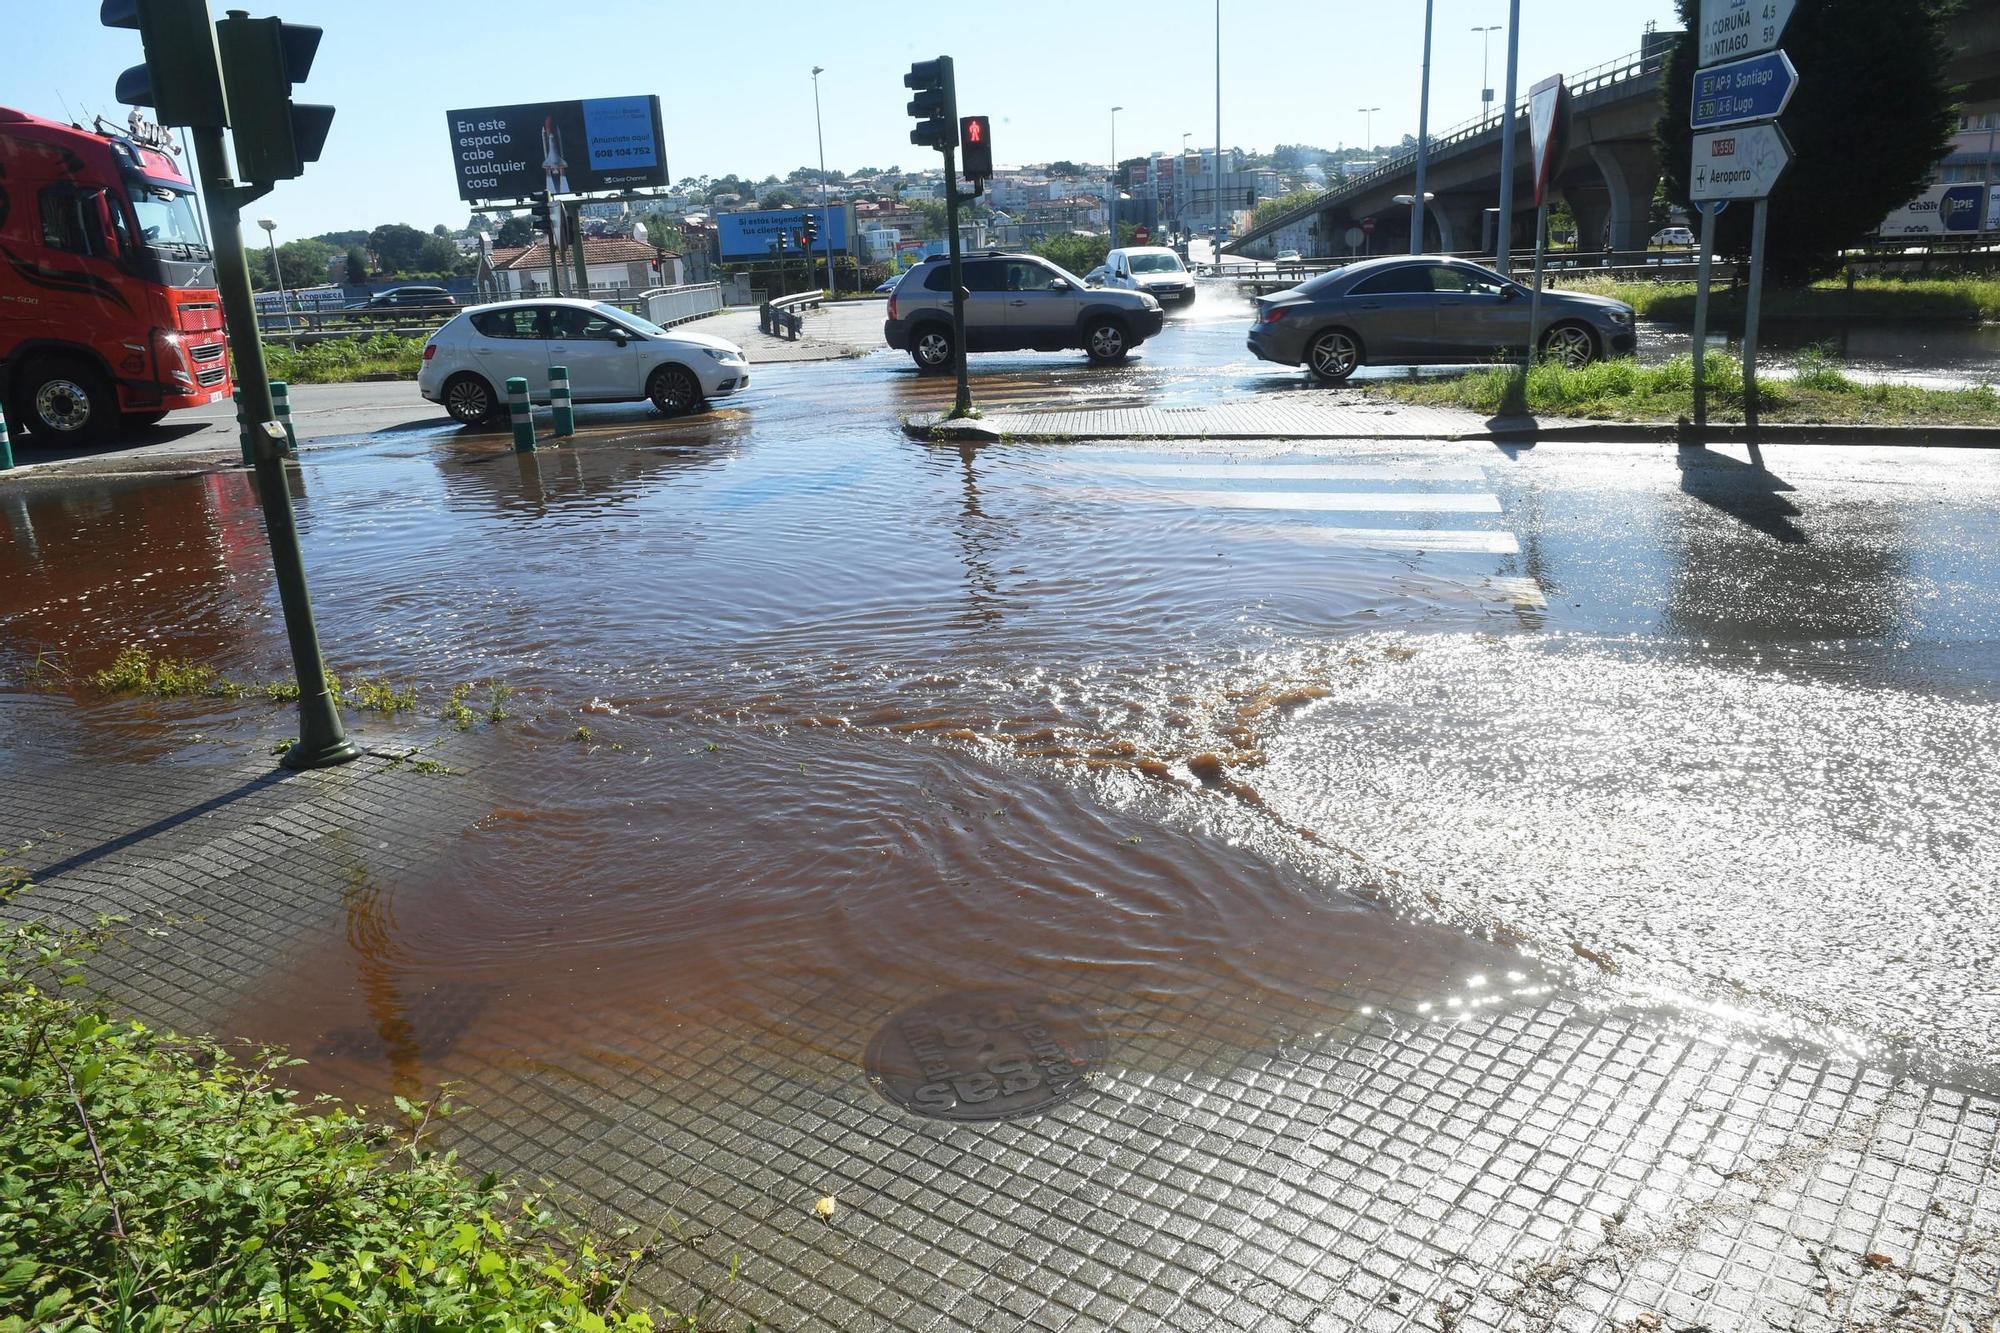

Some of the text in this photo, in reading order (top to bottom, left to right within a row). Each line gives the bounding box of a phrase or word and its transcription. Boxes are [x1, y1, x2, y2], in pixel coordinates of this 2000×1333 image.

[1712, 8, 1750, 36] CORUÑA
[1763, 25, 1774, 43] 59
[1715, 74, 1731, 91] AP-9
[1736, 69, 1773, 88] Santiago
[1733, 97, 1753, 113] Lugo
[457, 120, 506, 133] En este
[460, 132, 511, 148] espacio
[1712, 140, 1734, 156] N-550
[462, 149, 494, 161] cabe
[464, 160, 526, 175] cualquier
[467, 178, 497, 189] cosa
[1710, 169, 1751, 185] Aeroporto
